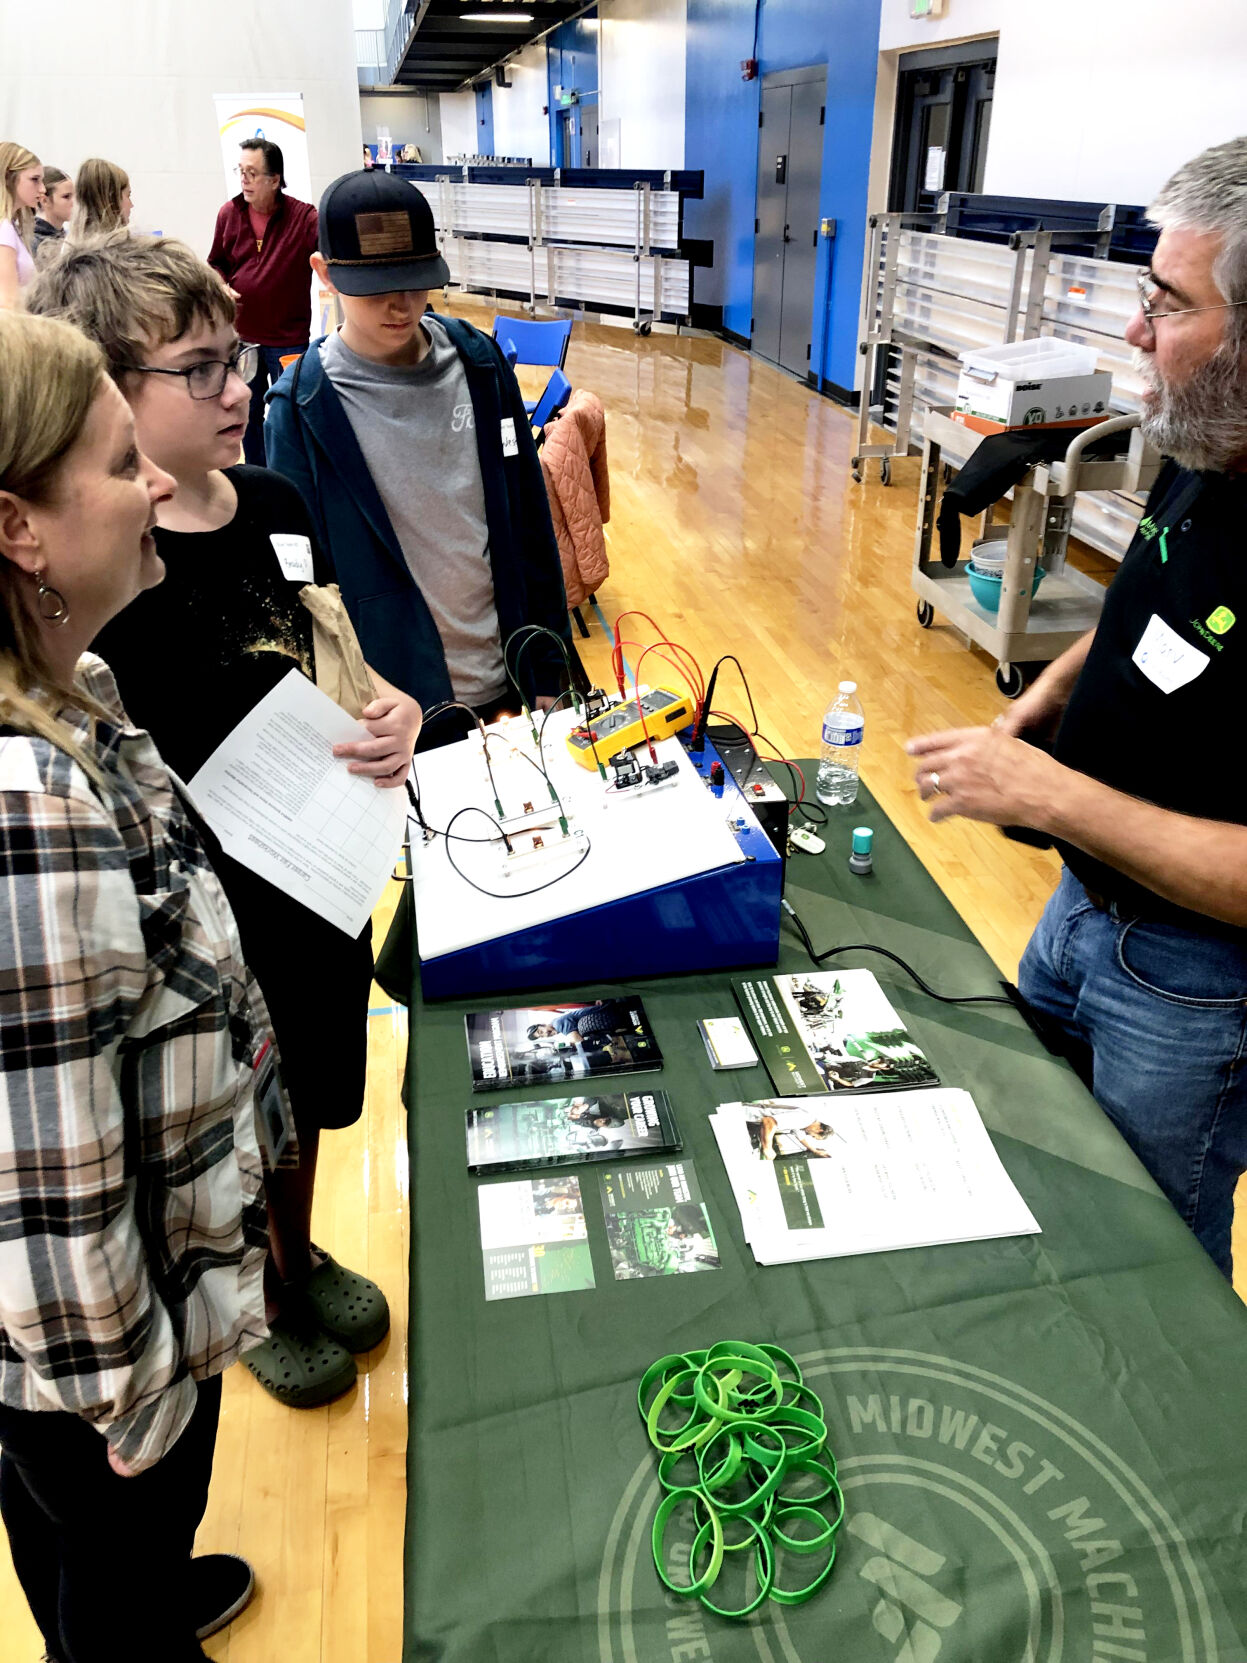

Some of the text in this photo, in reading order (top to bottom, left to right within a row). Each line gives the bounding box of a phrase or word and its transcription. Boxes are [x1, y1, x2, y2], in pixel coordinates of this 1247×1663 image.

[630, 1096, 649, 1137] YOUR CAREER
[642, 1095, 660, 1127] GROWING
[847, 1394, 1148, 1663] MIDWEST MACHI
